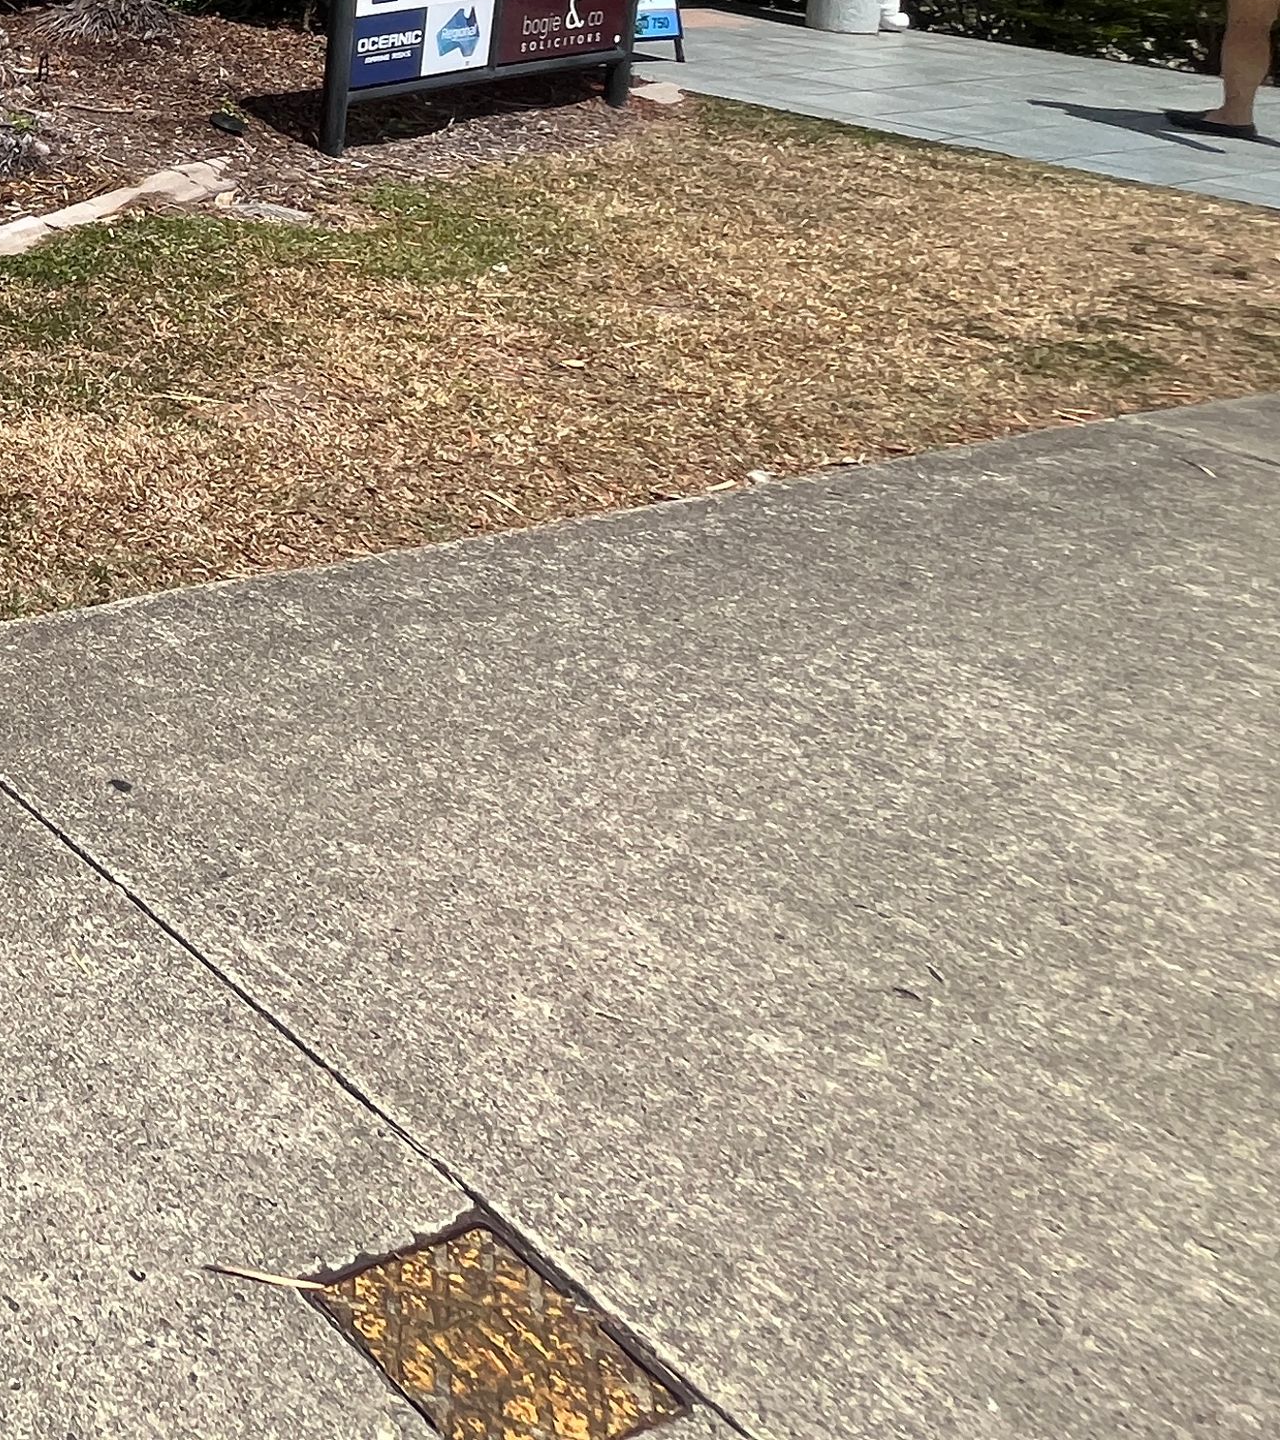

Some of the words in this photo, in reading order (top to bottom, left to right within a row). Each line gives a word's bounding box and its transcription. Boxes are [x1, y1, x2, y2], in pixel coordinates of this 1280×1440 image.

[522, 12, 562, 38] bogie
[587, 9, 604, 27] co
[357, 29, 423, 53] OCEANIC
[520, 32, 602, 53] SOLICITORS
